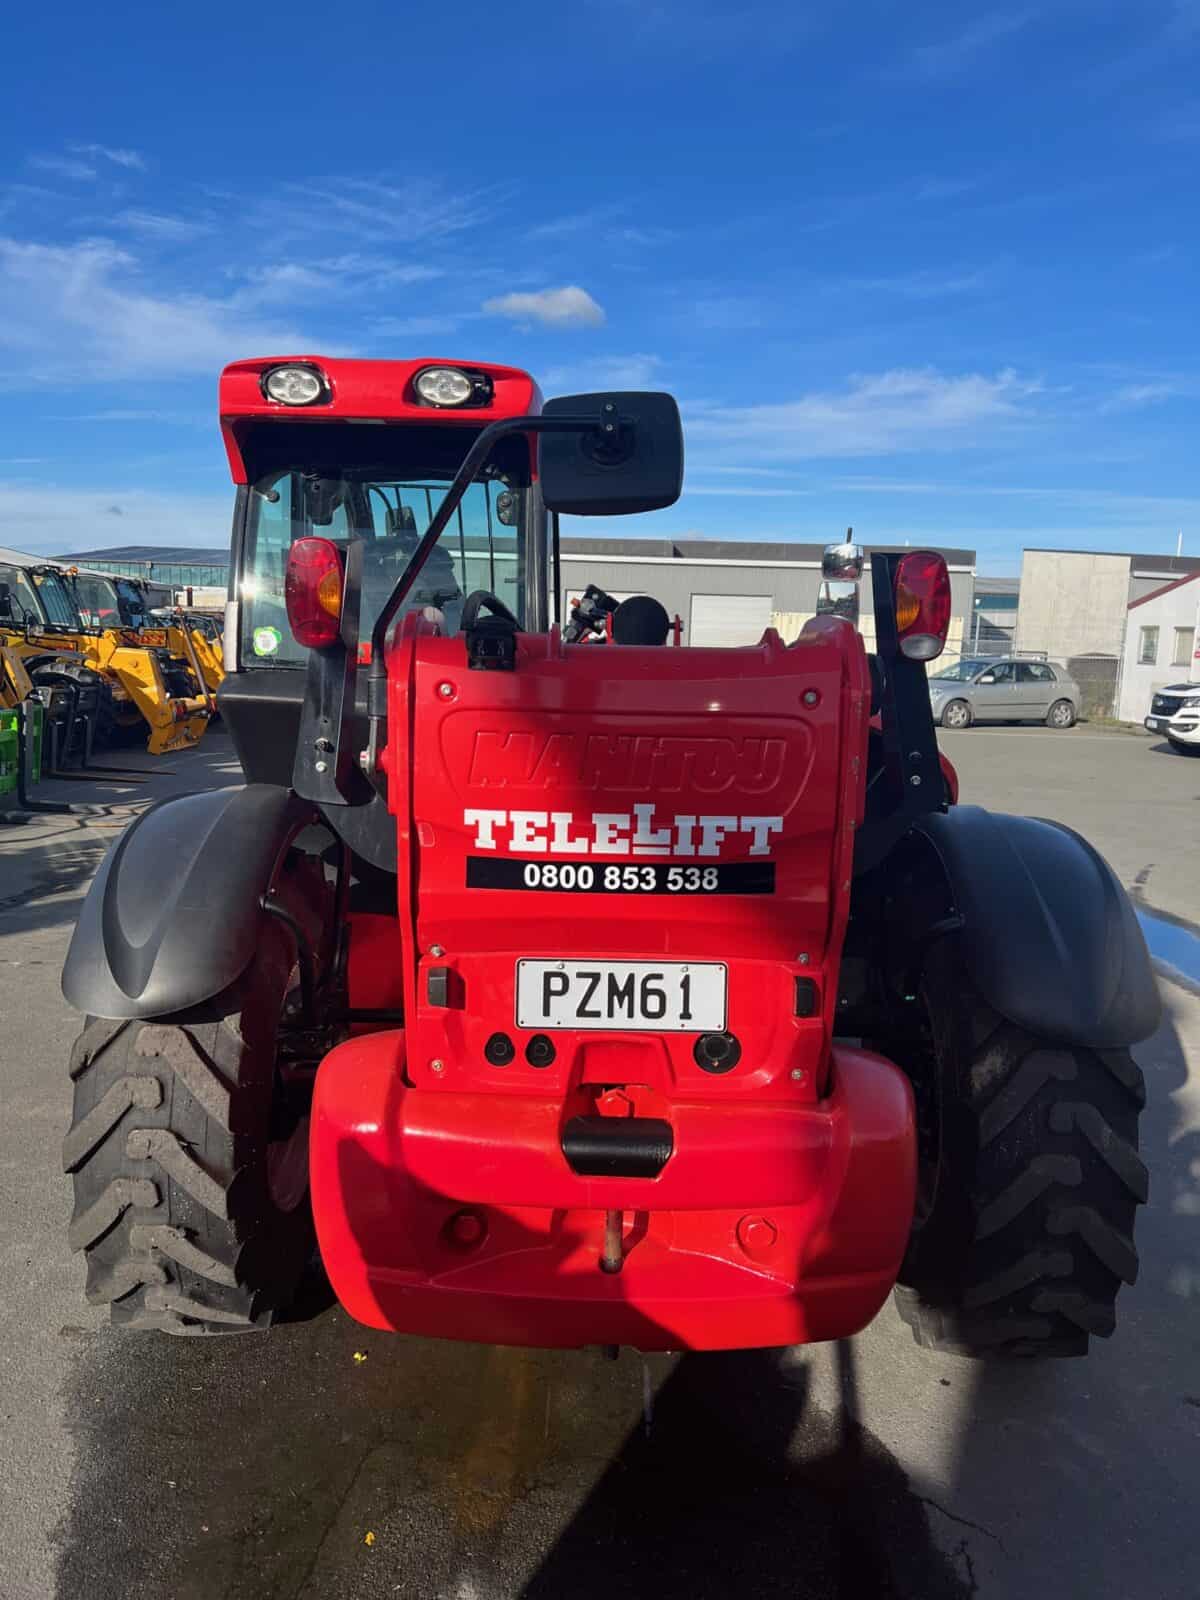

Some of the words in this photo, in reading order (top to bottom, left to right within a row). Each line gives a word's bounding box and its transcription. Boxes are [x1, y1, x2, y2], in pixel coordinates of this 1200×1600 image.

[523, 864, 594, 889] 0800
[603, 866, 657, 890] 853
[666, 867, 719, 891] 538
[541, 970, 693, 1021] PZM61
